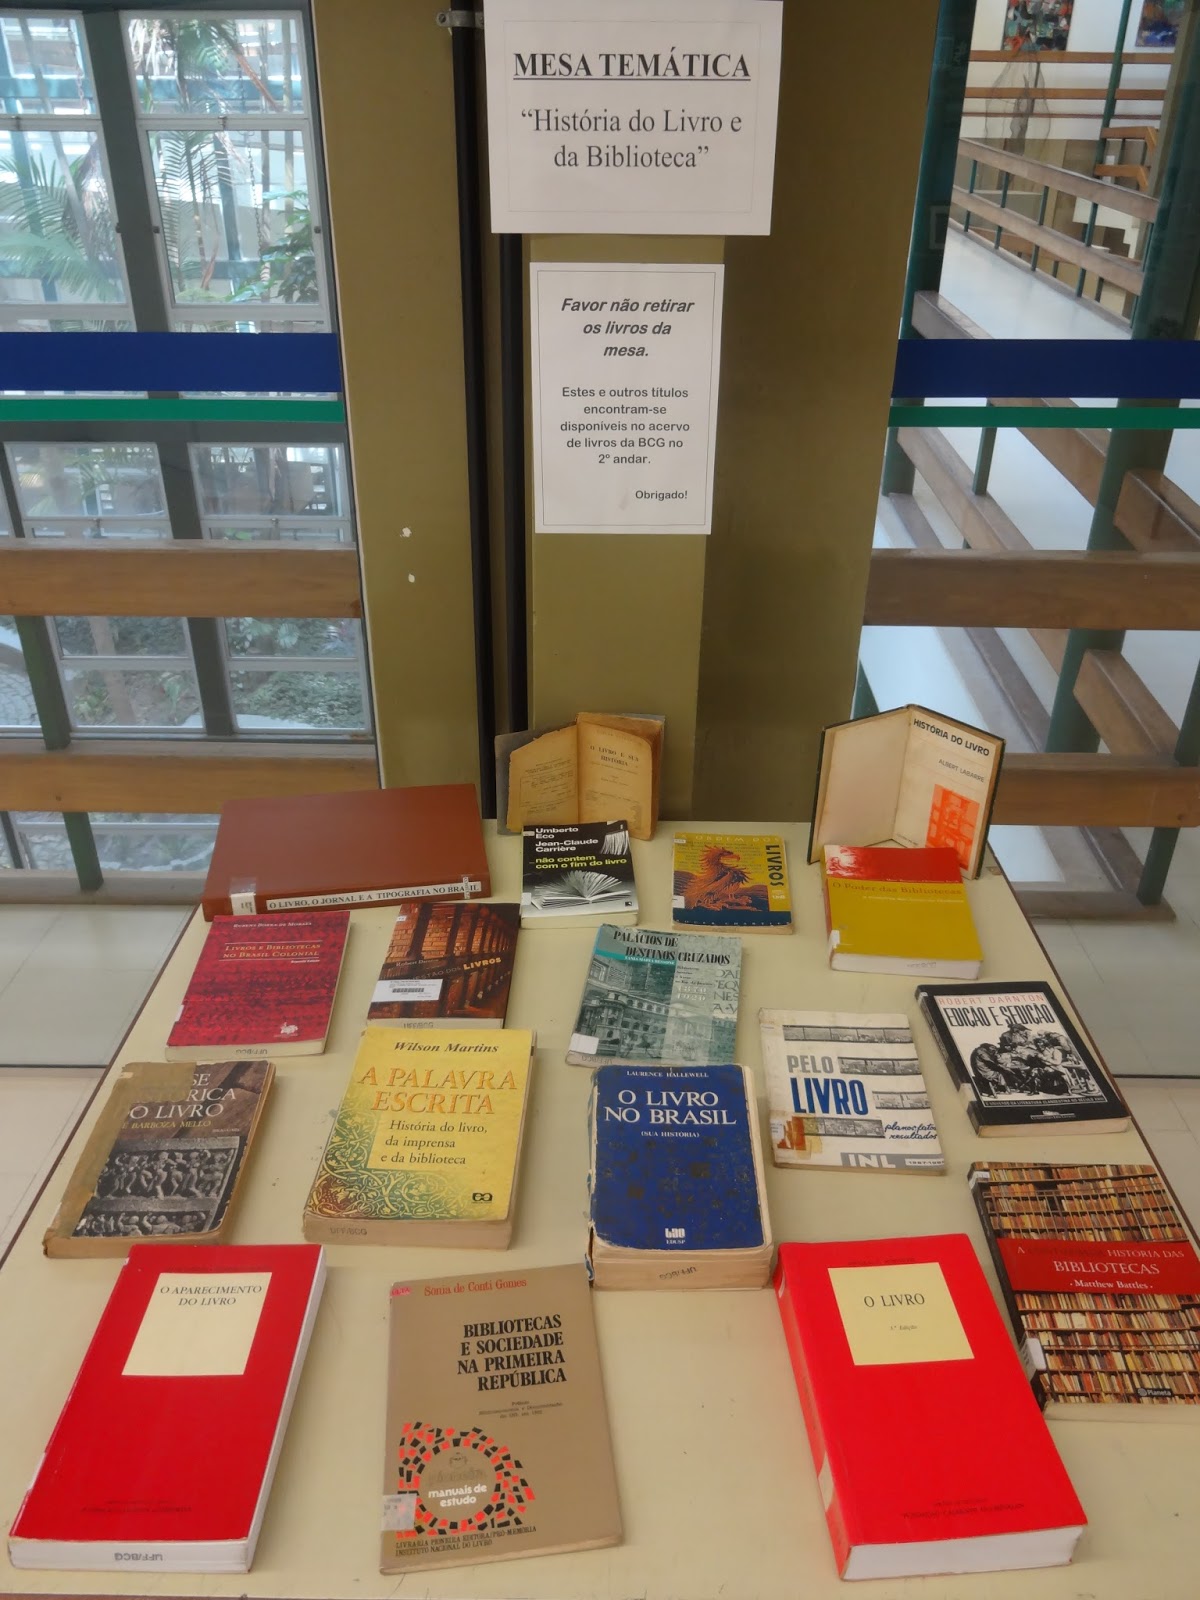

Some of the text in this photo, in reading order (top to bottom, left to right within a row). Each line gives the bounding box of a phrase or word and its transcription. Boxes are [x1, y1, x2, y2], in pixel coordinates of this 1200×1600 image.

[513, 47, 751, 80] MESA TEMÁTICA
[521, 108, 742, 132] “História do Livro e
[554, 146, 709, 168] da Biblioteca”
[561, 298, 695, 313] Favor não retirar
[583, 321, 672, 335] os livros da
[603, 345, 649, 357] mesa.
[562, 386, 689, 398] Estes e outros títulos
[583, 404, 667, 415] encontram-se
[560, 421, 690, 434] disponíveis no acervo
[566, 438, 683, 448] de livros da BCG no
[598, 454, 651, 464] 2º andar.
[635, 490, 688, 501] Obrigado!
[913, 718, 990, 757] HISTÓRIA DO LIVRO
[938, 758, 985, 783] ALBERT LABARRE
[536, 826, 579, 834] Umberto
[535, 838, 599, 847] Jean-Claude
[557, 855, 596, 863] contem
[765, 844, 785, 887] LIVROS
[269, 901, 277, 909] O
[312, 897, 319, 905] O
[320, 894, 357, 905] JORNAL
[376, 889, 431, 900] TIPOGRAFIA
[433, 887, 446, 895] NO
[447, 884, 479, 894] BRAIL
[613, 930, 679, 947] PALÁCIOS DE
[625, 946, 731, 966] DESTINOS CRUZADOS
[463, 957, 502, 971] LIVROS
[937, 993, 1045, 1006] ROBERT DARNTON
[943, 1003, 1056, 1028] EDIÇÃO E SEDIÇÃO
[394, 1042, 499, 1053] Wilson Martins
[786, 1054, 834, 1074] PELO
[358, 1066, 517, 1090] A PALAVRA
[626, 1070, 663, 1078] LAURENCE
[370, 1090, 495, 1115] ESCRITA
[618, 1090, 719, 1107] O LIVRO
[790, 1077, 869, 1116] LIVRO
[155, 1103, 224, 1119] LIVRO
[604, 1106, 737, 1125] NO BRASIL
[131, 1121, 176, 1129] BARBOZA
[180, 1120, 211, 1128] MELLO
[389, 1119, 488, 1134] História do livro,
[641, 1130, 700, 1139] (SUA HISTÓRIA)
[889, 1131, 938, 1140] resultados
[385, 1135, 456, 1150] da imprensa
[391, 1153, 405, 1163] da
[409, 1152, 466, 1165] biblioteca
[848, 1154, 896, 1169] INL
[1017, 1246, 1026, 1254] A
[1163, 1250, 1185, 1258] DAS
[1053, 1260, 1161, 1274] BIBLIOTECAS
[160, 1285, 262, 1295] O APARECIMENTO
[454, 1282, 465, 1294] de
[468, 1280, 493, 1292] Conti
[495, 1278, 527, 1290] Gomes
[1074, 1279, 1149, 1289] Matthew Battles
[178, 1297, 237, 1306] DO LIVRO
[863, 1292, 925, 1308] O LIVRO
[464, 1314, 562, 1338] BIBLIOTECAS
[461, 1331, 564, 1356] E SOCIEDADE
[457, 1350, 566, 1375] NA PRIMEIRA
[477, 1367, 567, 1392] REPÚBLICA
[428, 1484, 487, 1498] manuais de
[440, 1495, 477, 1507] estudo
[396, 1540, 429, 1549] LIVRARIA
[462, 1541, 471, 1549] DO
[472, 1539, 493, 1548] LIVRO
[114, 1552, 163, 1563] UFF/BCG
